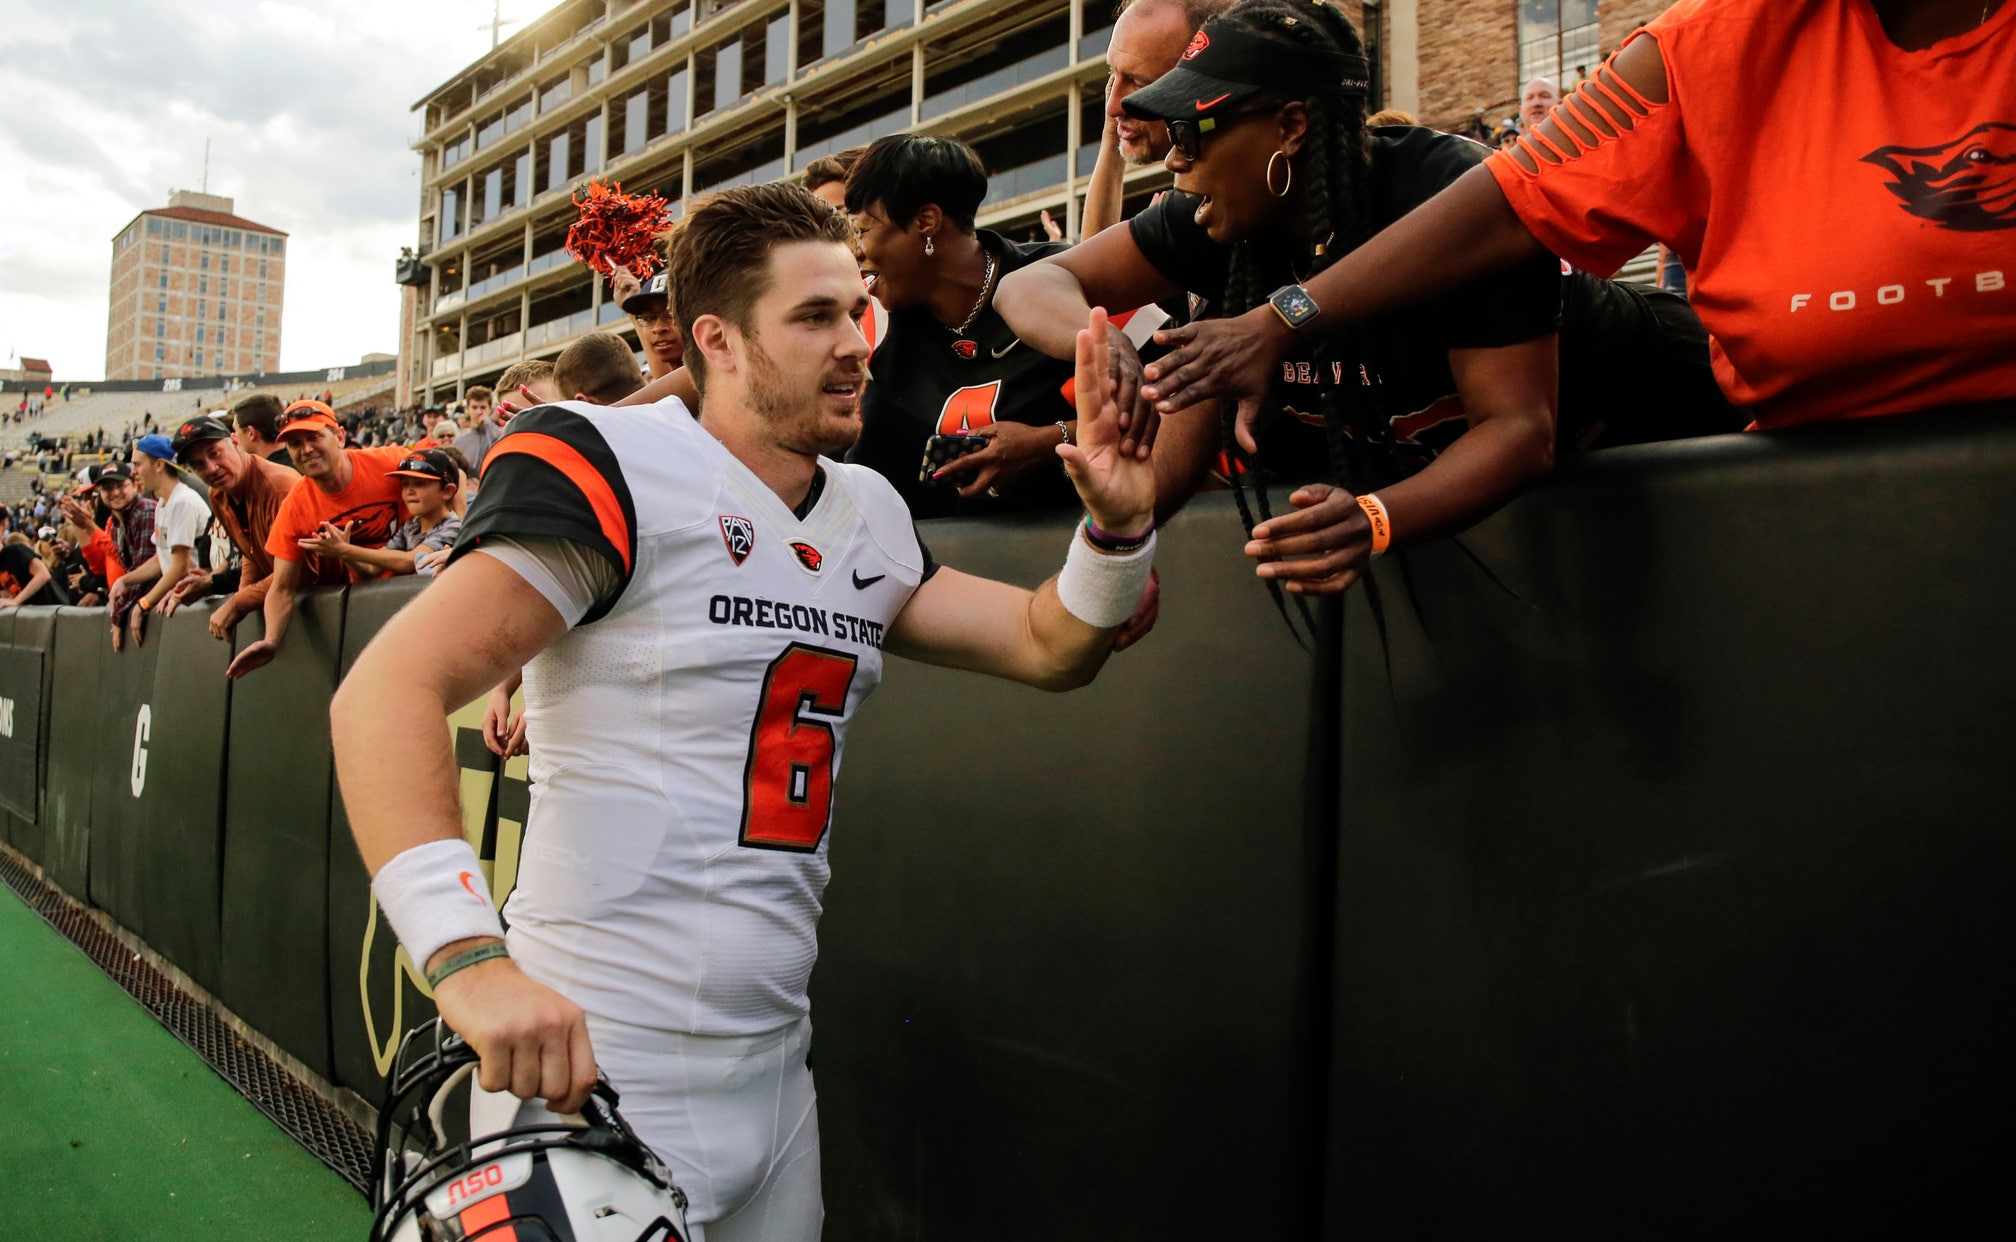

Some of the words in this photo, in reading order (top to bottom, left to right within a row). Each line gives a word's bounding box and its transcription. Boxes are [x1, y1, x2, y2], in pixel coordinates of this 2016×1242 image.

[1790, 270, 2005, 313] FOOTB
[163, 378, 182, 391] 205
[721, 516, 752, 547] PAC
[731, 535, 747, 555] 12
[709, 595, 829, 635] OREGON
[832, 612, 884, 649] STATE
[131, 704, 151, 797] G
[738, 641, 858, 854] 6
[448, 1163, 503, 1205] OSU
